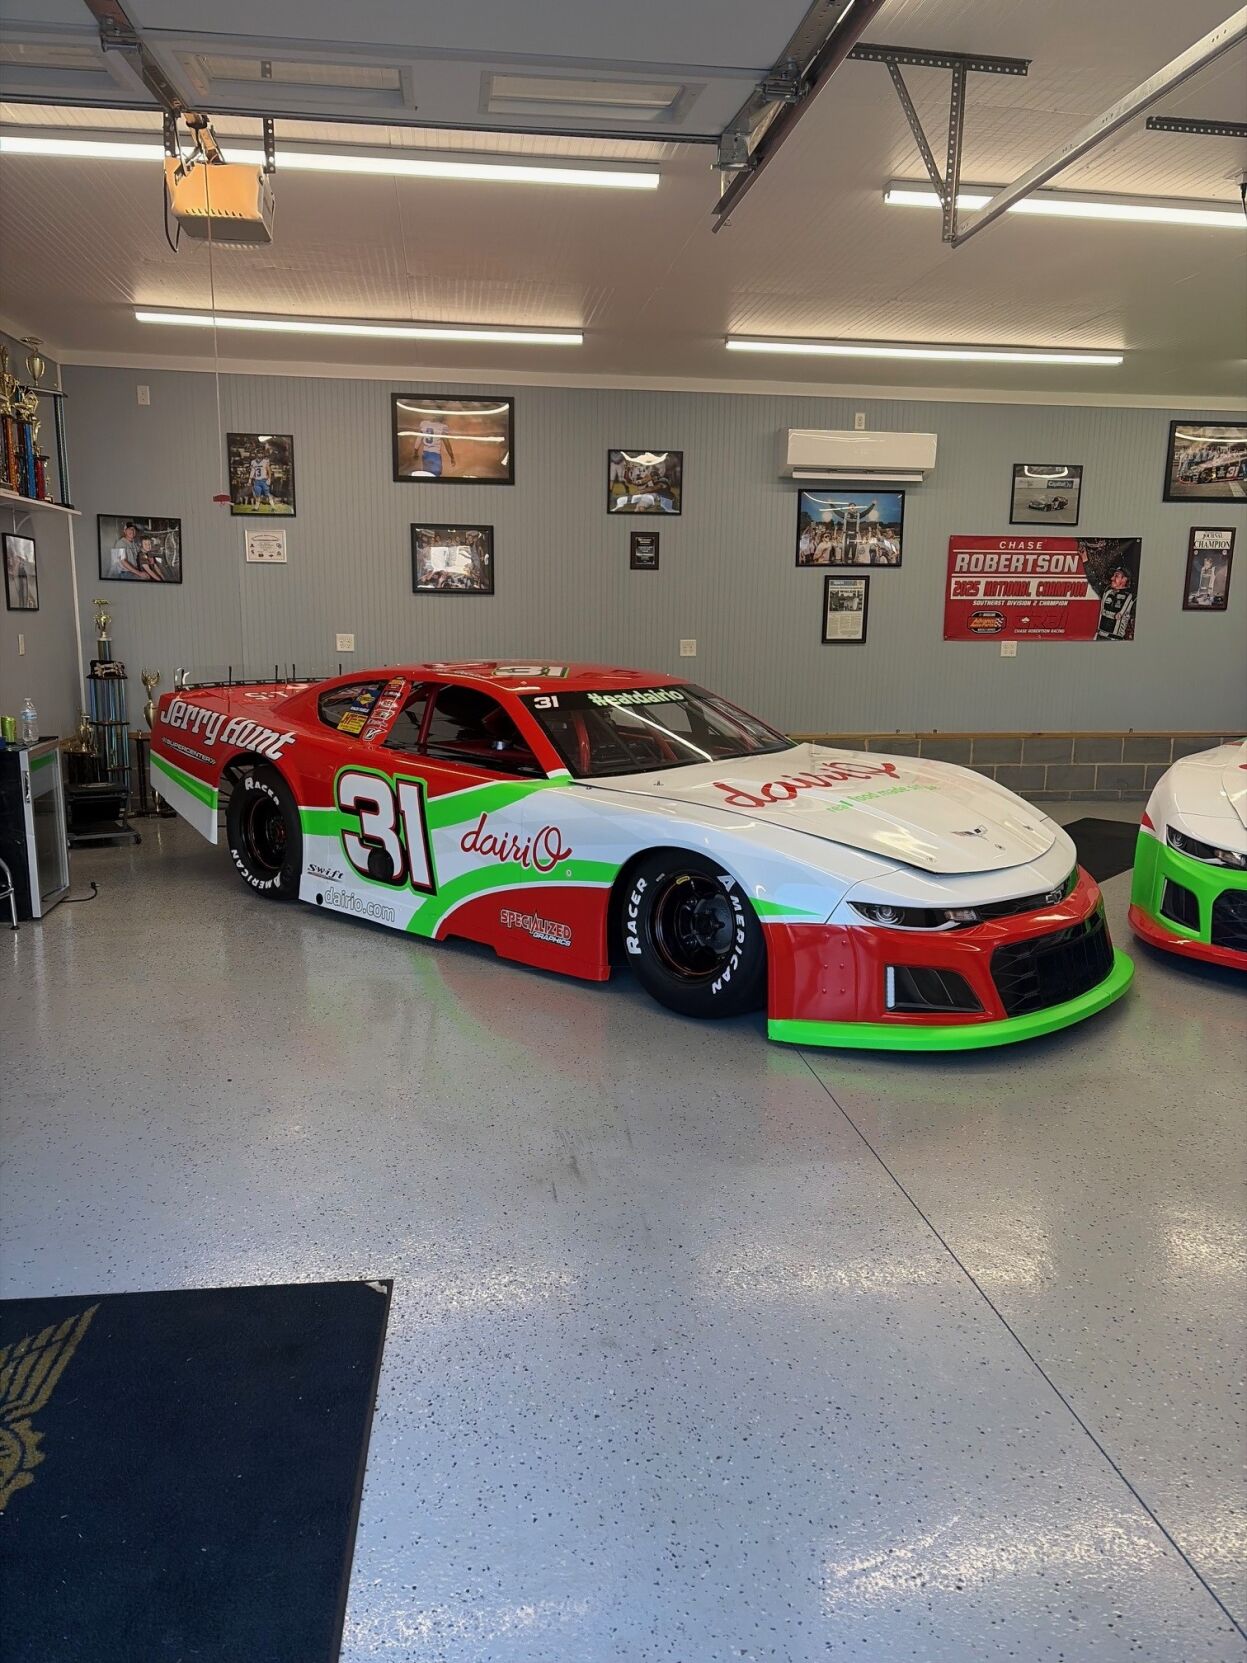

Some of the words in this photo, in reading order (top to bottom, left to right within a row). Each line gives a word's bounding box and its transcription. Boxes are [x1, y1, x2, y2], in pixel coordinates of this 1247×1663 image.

[1226, 466, 1240, 478] 31
[999, 541, 1044, 550] CHASE
[1194, 540, 1231, 548] CHAMPION
[954, 553, 1080, 573] ROBERTSON
[952, 580, 981, 597] 2025
[983, 580, 1031, 597] NATIONAL
[1035, 580, 1089, 598] CHAMPION
[493, 666, 568, 678] 31
[534, 695, 559, 709] 31
[587, 688, 685, 707] #eatdairio
[161, 699, 228, 746] Jerry
[220, 716, 297, 760] Hunt
[165, 738, 214, 763] SUPERCENTER
[244, 776, 280, 806] RACER
[337, 769, 437, 896] 31
[231, 849, 281, 890] AMERICAN
[307, 864, 344, 880] Swift
[324, 886, 396, 922] dairio.com
[500, 909, 572, 940] SPECIALIZED
[626, 877, 648, 955] RACER
[533, 931, 572, 947] GRAPHICS
[712, 875, 745, 995] AMERICAN
